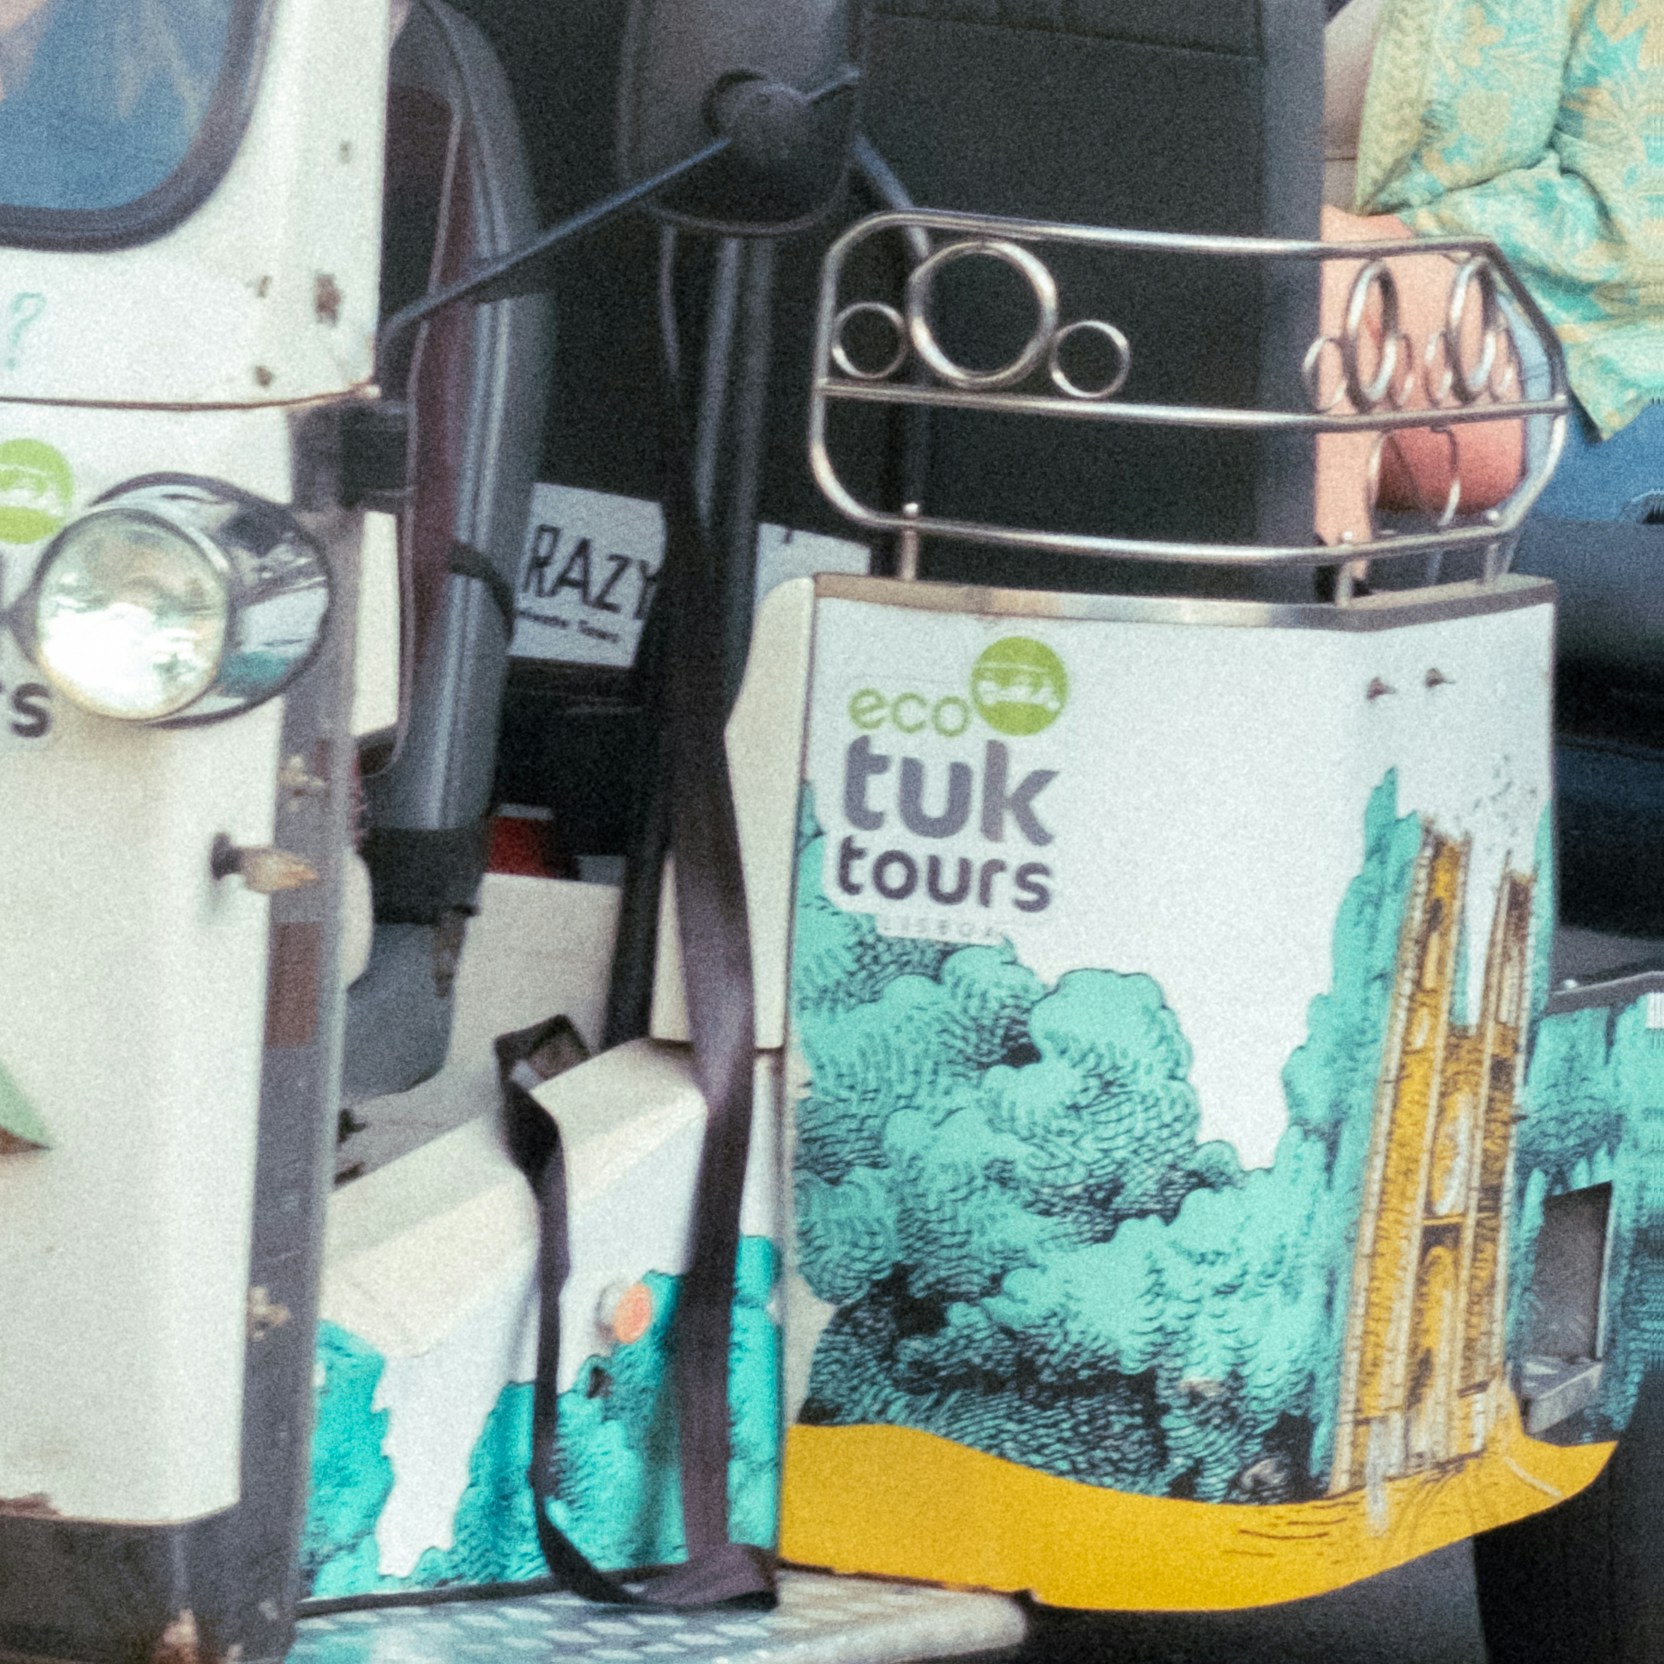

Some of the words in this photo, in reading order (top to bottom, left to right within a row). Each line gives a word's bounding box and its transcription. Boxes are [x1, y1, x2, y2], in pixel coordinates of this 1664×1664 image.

[848, 687, 969, 738] eco
[844, 734, 1061, 847] tuk
[838, 835, 1053, 913] tours
